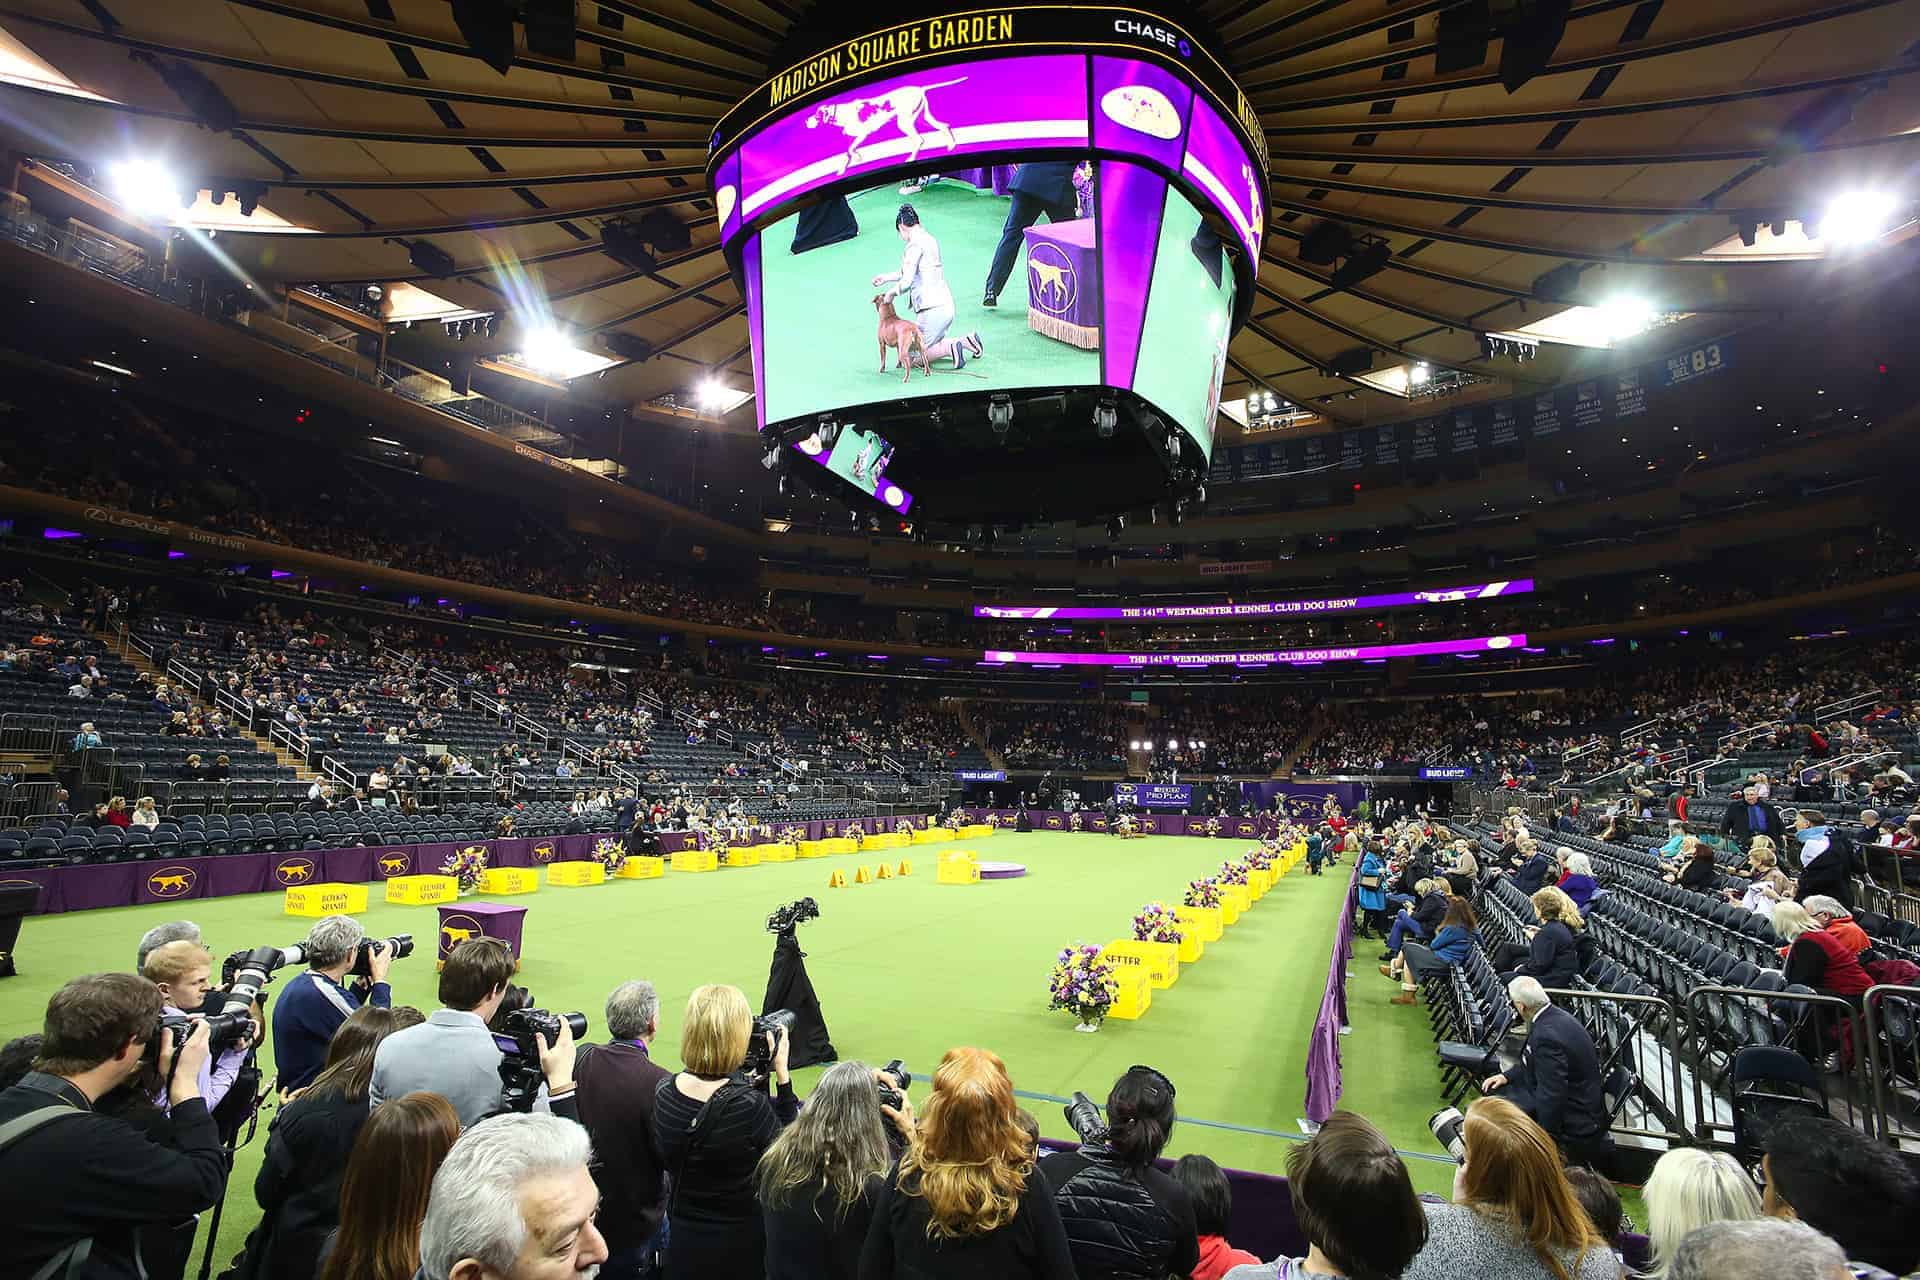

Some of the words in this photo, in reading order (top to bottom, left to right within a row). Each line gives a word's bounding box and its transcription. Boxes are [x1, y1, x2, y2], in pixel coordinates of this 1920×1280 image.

[1114, 19, 1177, 48] CHASE
[770, 51, 841, 107] MADISON
[847, 27, 922, 71] SQUARE
[928, 13, 1013, 49] GARDEN
[1691, 344, 1721, 372] 83
[514, 445, 541, 461] CHASE
[188, 531, 217, 545] SUITE
[218, 536, 248, 551] LEVEL
[1122, 608, 1140, 617] THE
[1166, 606, 1232, 616] WESTMINSTER
[1234, 603, 1273, 614] KENNEL
[1275, 602, 1301, 612] CLUB
[1303, 600, 1326, 610] DOG
[1327, 598, 1357, 609] SHOW
[1129, 655, 1147, 664] THE
[1172, 653, 1237, 664] WESTMINSTER
[1239, 652, 1277, 662] KENNEL
[1279, 652, 1305, 662] CLUB
[1306, 650, 1328, 660] DOG
[1329, 648, 1359, 659] SHOW
[1426, 769, 1442, 777] BUD
[1442, 769, 1465, 777] LIGHT
[320, 901, 348, 911] SPANIEL
[1105, 954, 1141, 966] SETTER
